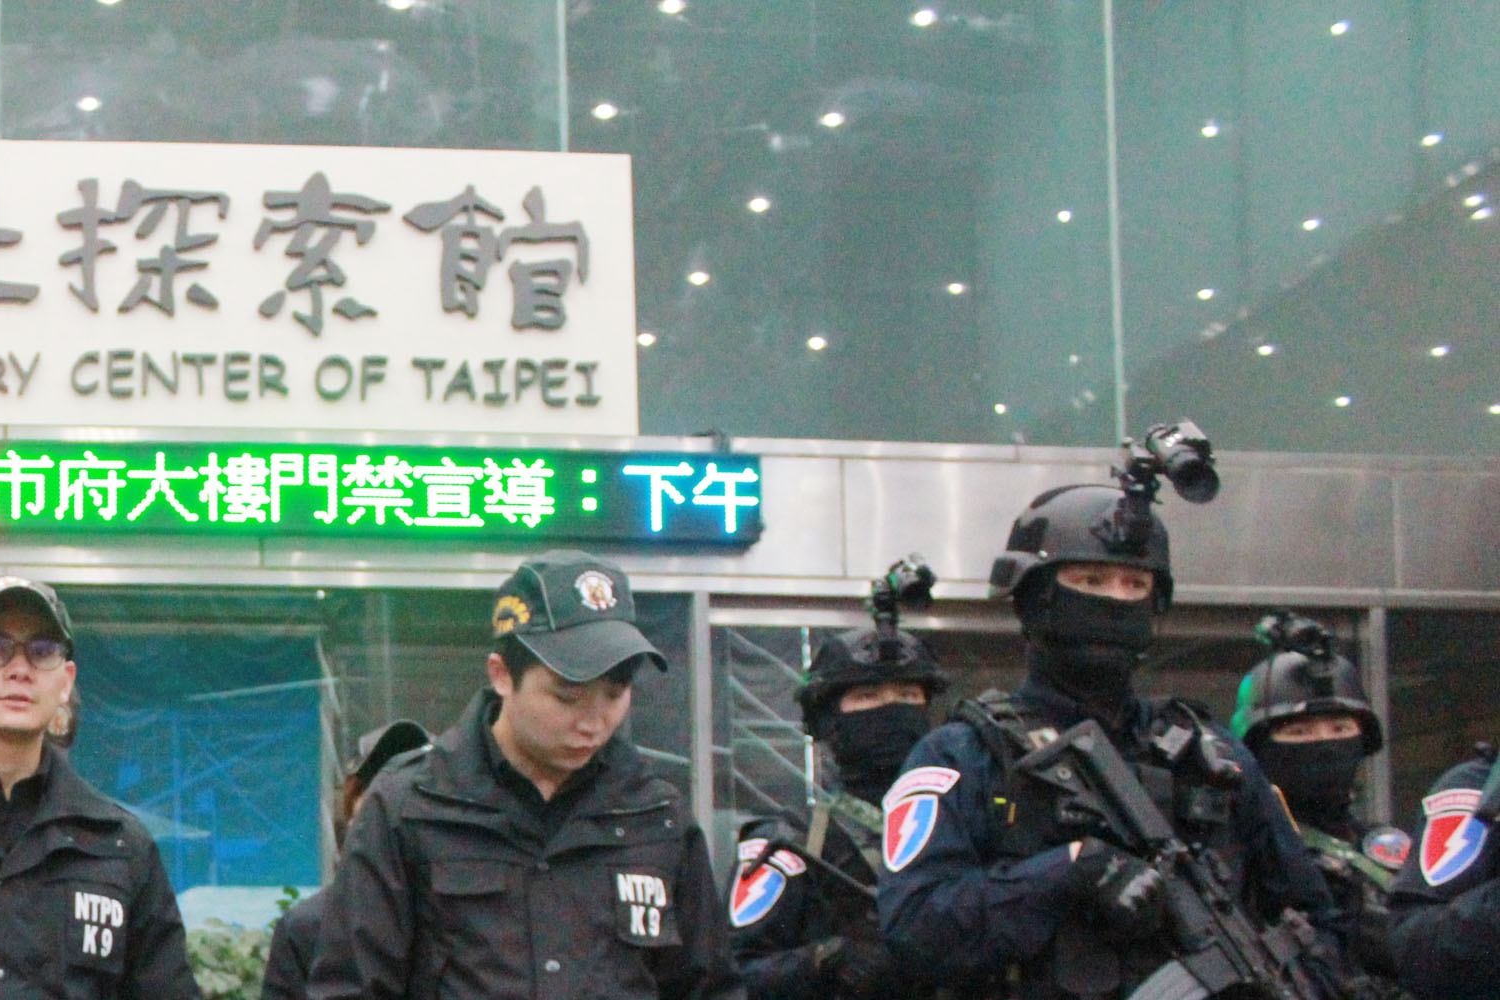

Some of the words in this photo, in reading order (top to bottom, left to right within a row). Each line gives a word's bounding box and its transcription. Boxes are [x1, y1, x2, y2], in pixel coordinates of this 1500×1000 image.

[70, 349, 289, 400] CENTER
[314, 355, 392, 402] OF
[413, 358, 602, 408] TAIPEI
[616, 873, 667, 907] NTPD
[74, 891, 124, 928] NTPD
